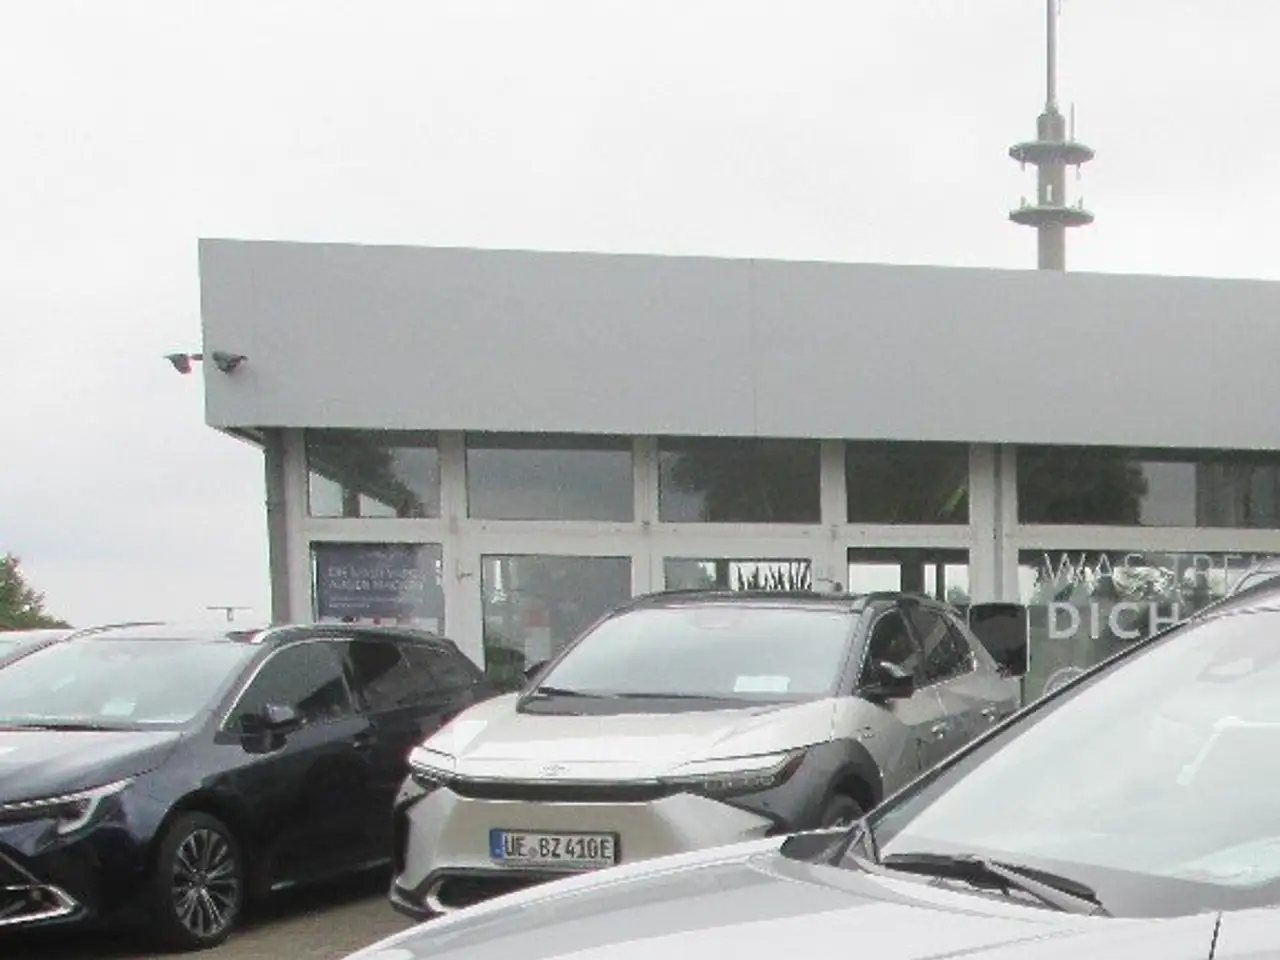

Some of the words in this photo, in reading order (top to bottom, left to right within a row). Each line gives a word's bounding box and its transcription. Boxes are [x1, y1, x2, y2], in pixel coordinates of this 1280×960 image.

[1048, 601, 1180, 640] DICH
[504, 834, 528, 858] UE
[539, 837, 562, 859] BZ
